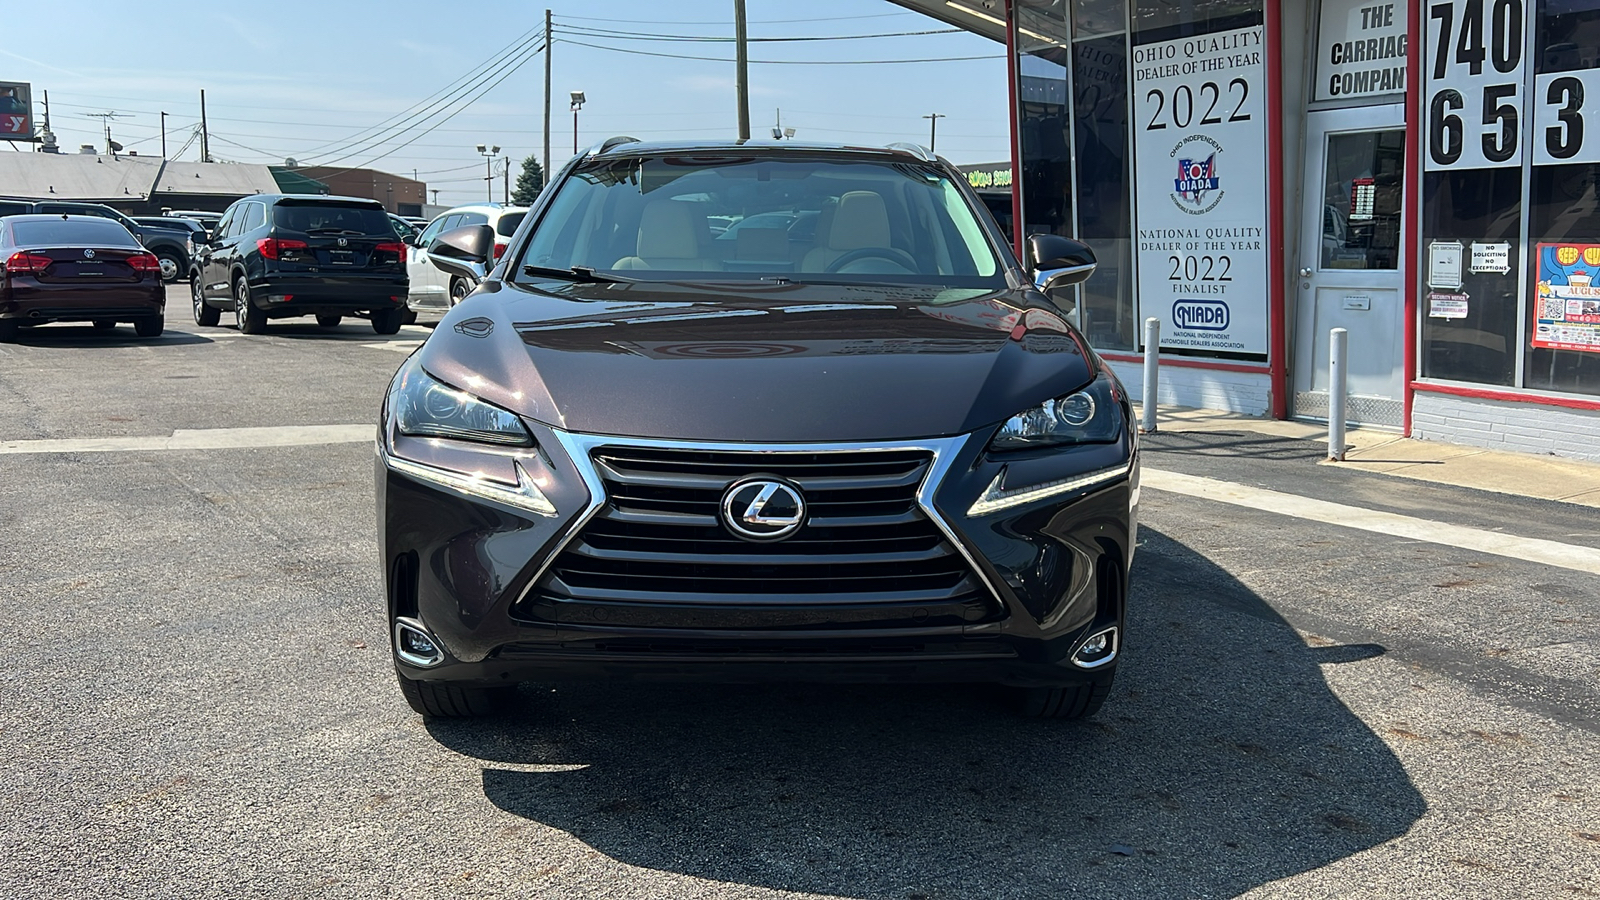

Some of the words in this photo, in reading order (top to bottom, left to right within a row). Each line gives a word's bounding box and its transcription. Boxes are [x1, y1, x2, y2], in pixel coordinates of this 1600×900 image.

[1361, 4, 1394, 30] THE
[1134, 44, 1176, 64] OHIO
[1184, 30, 1262, 58] QUALITY
[1331, 34, 1408, 65] CARRIAG
[1431, 0, 1522, 80] 740
[1136, 64, 1180, 81] DEALER
[1182, 62, 1198, 74] OF
[1200, 58, 1224, 72] THE
[1227, 52, 1260, 68] YEAR
[1330, 67, 1407, 96] COMPAN
[1146, 78, 1251, 131] 2022
[1170, 141, 1183, 158] OHIO
[1182, 134, 1223, 153] INDEPENDENT
[1180, 178, 1212, 191] OIADA
[1140, 229, 1200, 239] NATIONAL
[1206, 228, 1262, 239] QUALITY
[1142, 242, 1181, 251] DEALER
[1186, 242, 1199, 251] OF
[1204, 242, 1226, 250] THE
[1230, 241, 1260, 250] YEAR
[1168, 255, 1233, 281] 2022
[1558, 247, 1579, 264] BEER
[1173, 284, 1226, 294] FINALIST
[1568, 288, 1600, 296] AUGUS
[1177, 306, 1224, 326] NIADA
